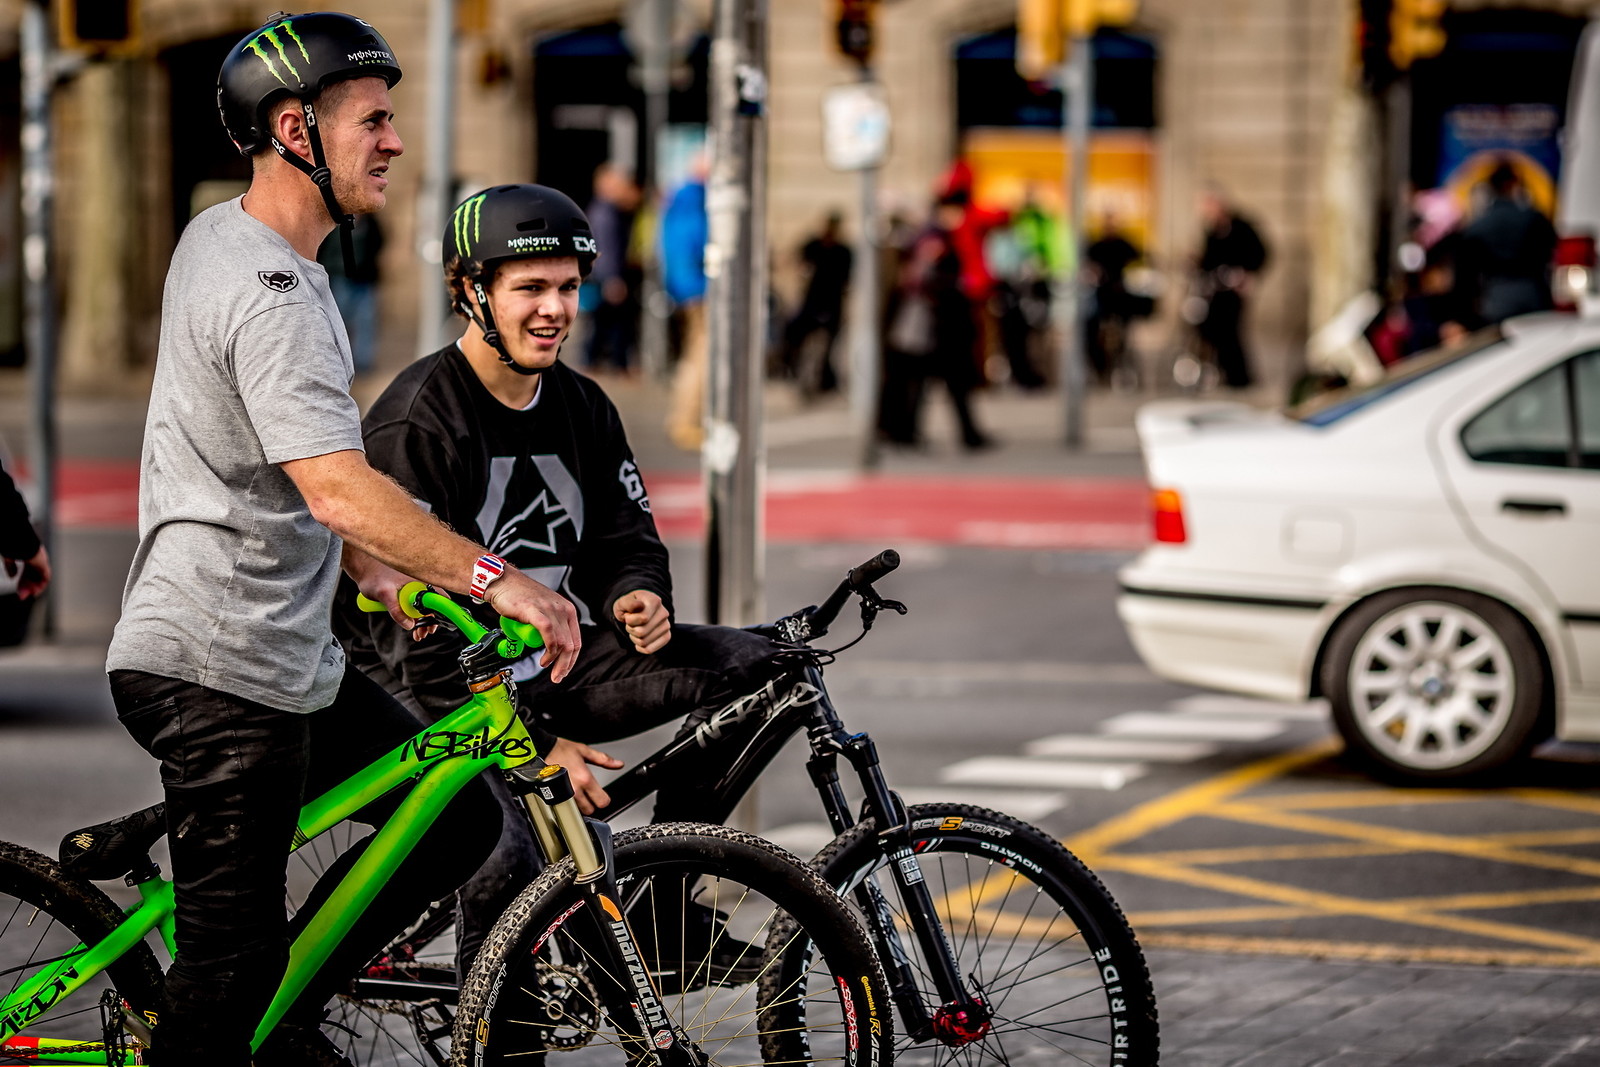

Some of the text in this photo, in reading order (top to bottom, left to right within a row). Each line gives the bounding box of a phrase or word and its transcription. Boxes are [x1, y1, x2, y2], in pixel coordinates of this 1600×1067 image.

[347, 50, 392, 61] MONSTER
[507, 236, 560, 248] MONSTER
[980, 841, 1043, 875] NOVATEC
[609, 921, 668, 1028] marzocchi
[1095, 946, 1129, 1067] IRTRIDE
